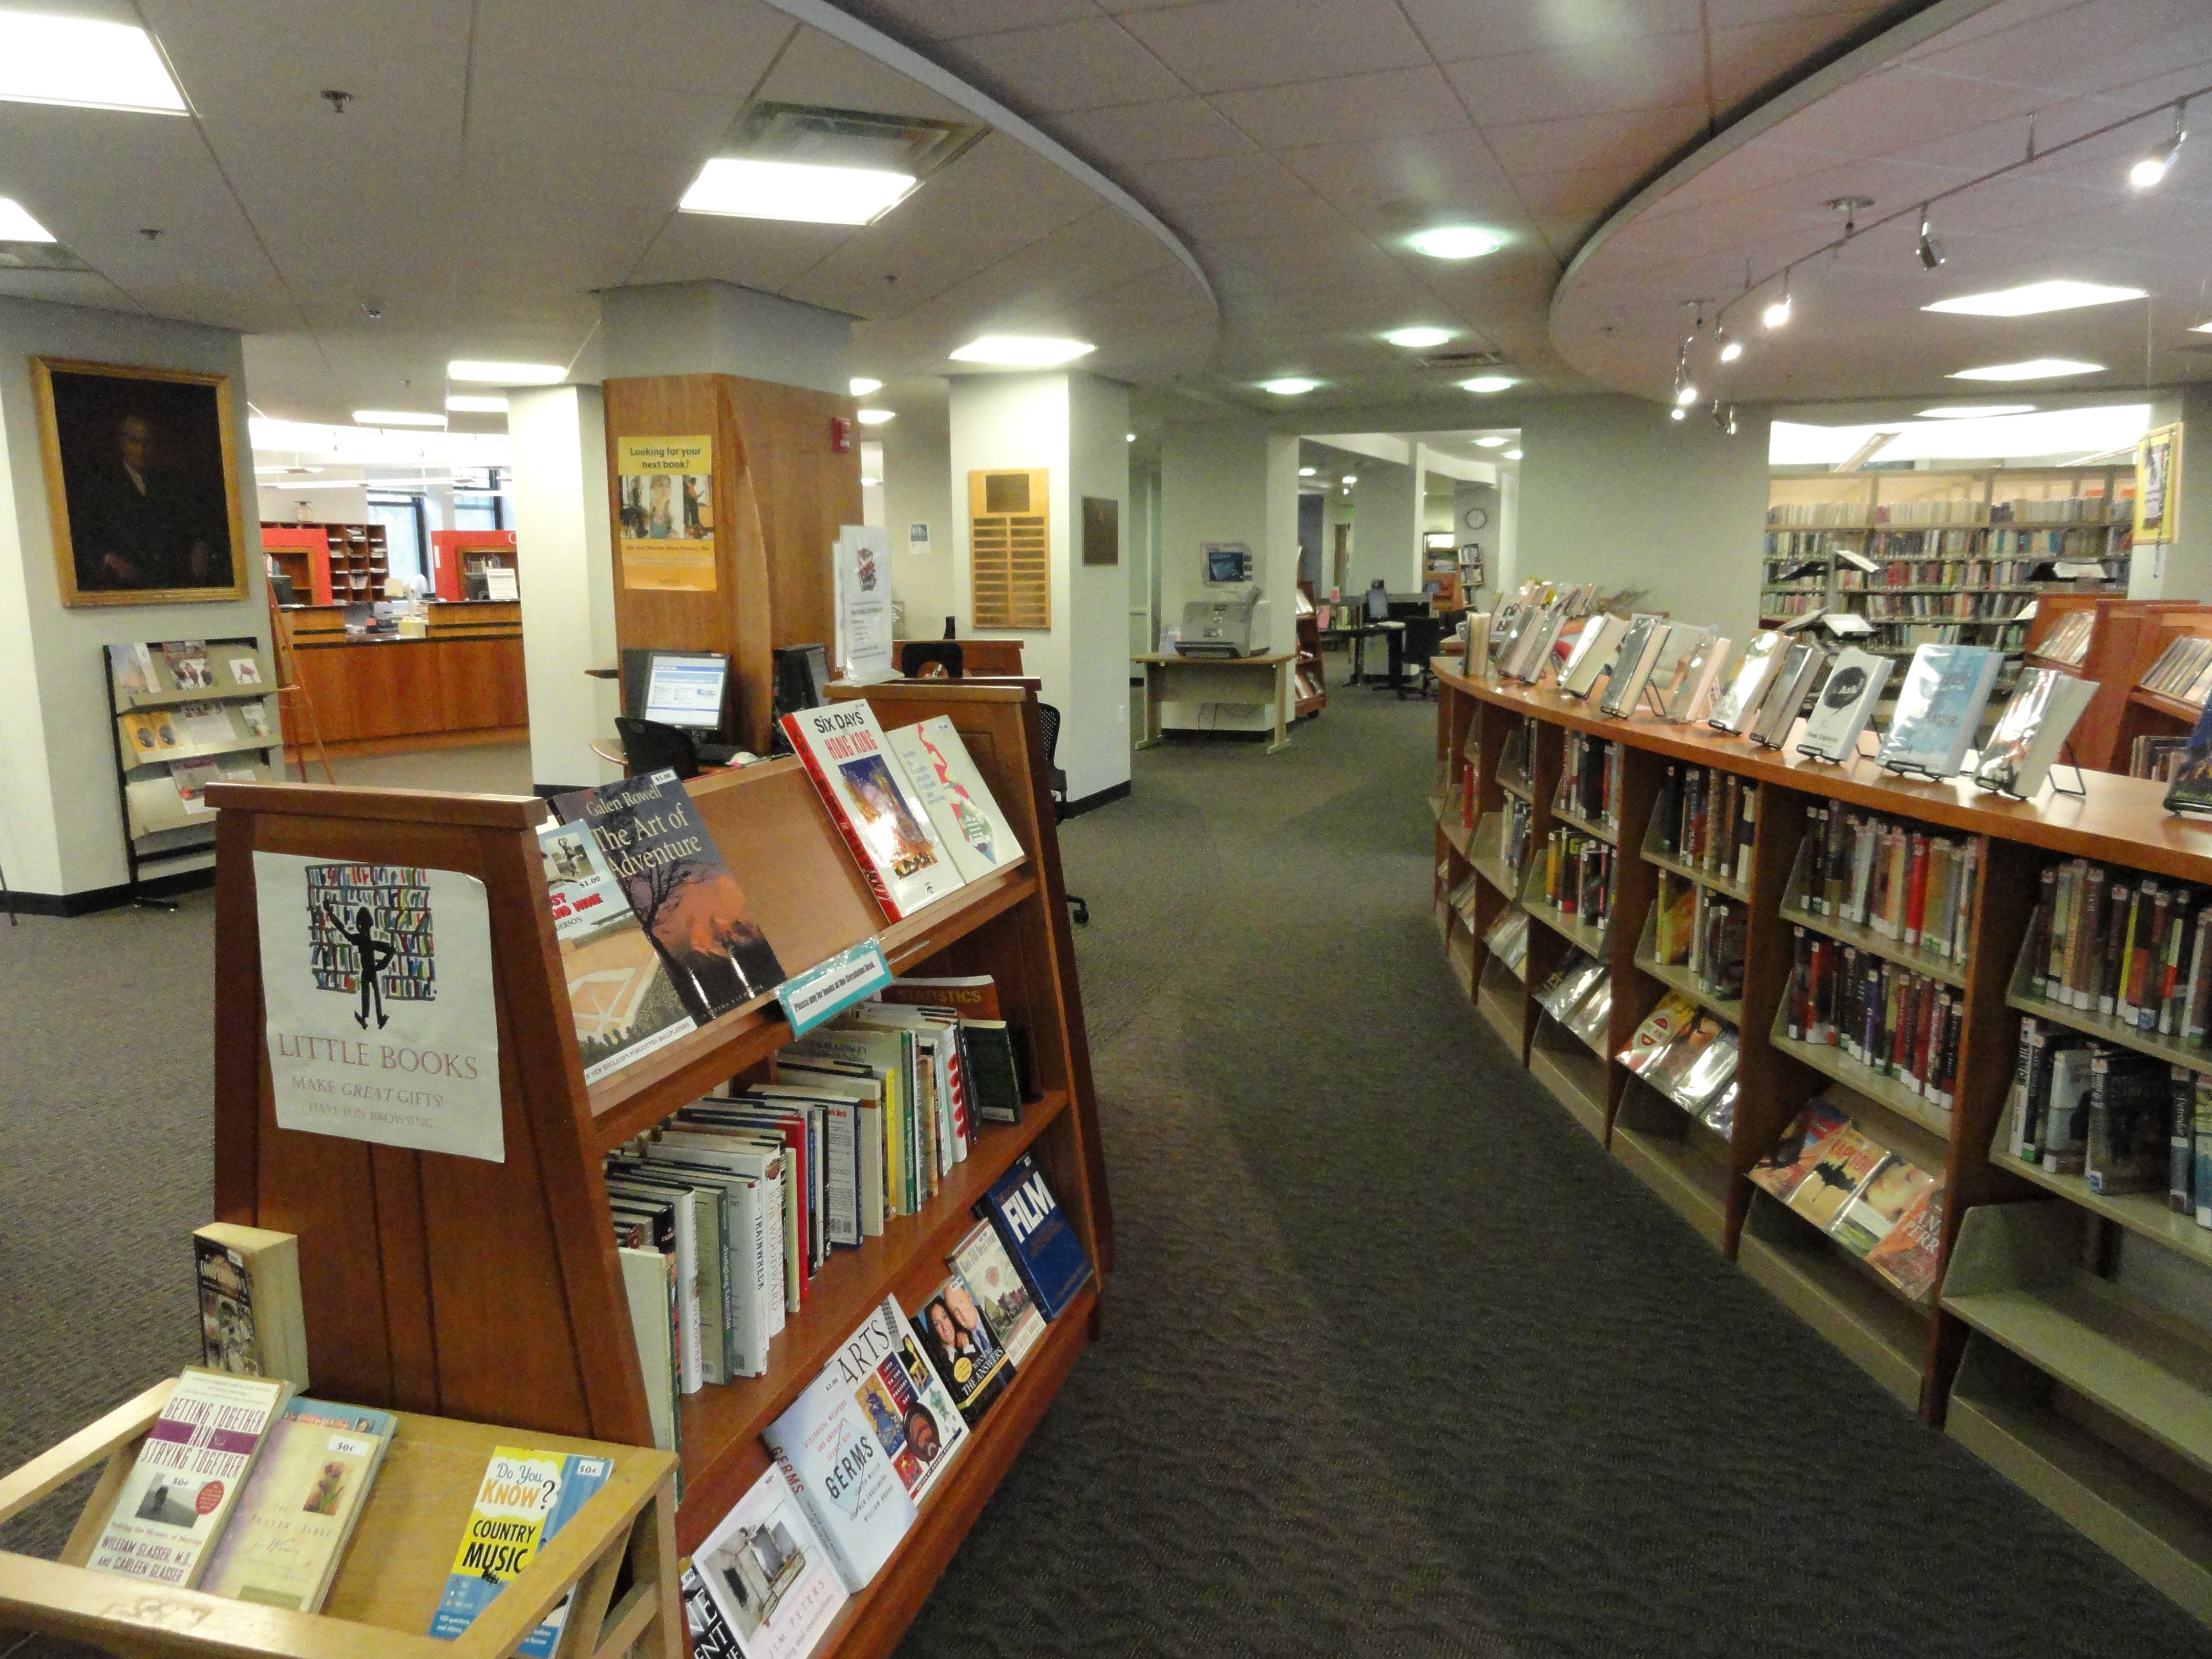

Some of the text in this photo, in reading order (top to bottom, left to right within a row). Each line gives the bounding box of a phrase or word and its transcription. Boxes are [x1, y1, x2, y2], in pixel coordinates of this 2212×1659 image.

[630, 446, 701, 458] Looking for your
[642, 459, 690, 470] next book?
[834, 711, 865, 730] DAYS
[824, 729, 878, 760] HONG KONG
[586, 783, 662, 817] Galen Rowell
[593, 802, 690, 852] The Art of
[608, 835, 702, 880] Adventure
[579, 876, 601, 889] $1.00
[572, 892, 604, 912] NINE
[794, 998, 810, 1012] Please
[809, 995, 818, 1005] pay
[822, 984, 836, 996] books
[834, 981, 840, 989] at
[845, 966, 865, 983] Circulation
[898, 989, 982, 1003] STATISTICS
[279, 1033, 478, 1080] LITTLE BOOKS
[603, 1054, 630, 1072] ENGLAND'S
[629, 1039, 658, 1056] FORGOTTEN
[658, 1022, 691, 1043] BALLPLAYERS
[292, 1075, 444, 1108] MAKE GREAT GIFTS!
[343, 1108, 366, 1120] FUN
[1001, 1170, 1056, 1244] FILM
[755, 1214, 764, 1291] TRAINWRECK
[769, 1224, 779, 1311] WOODWARD
[723, 1244, 732, 1330] Judging Lincoln
[692, 1301, 701, 1373] WOODWARD
[837, 1320, 890, 1386] ARTS
[825, 1377, 839, 1392] $1.00
[962, 1346, 1004, 1397] THE ANSWERS
[165, 1396, 215, 1424] GETTING
[212, 1405, 266, 1433] TOGETHER
[188, 1424, 216, 1448] AND
[143, 1438, 245, 1479] STAYING TOGETHER
[496, 1462, 543, 1484] Do You
[772, 1447, 804, 1494] GERMS
[825, 1435, 874, 1500] GERMS
[250, 1514, 291, 1529] PRAYER
[302, 1524, 333, 1538] JABEZ
[472, 1519, 537, 1544] COUNTRY
[101, 1536, 137, 1554] WILLIAM
[461, 1541, 529, 1575] MUSIC
[97, 1556, 184, 1583] AND CARLEEN GLASSER
[768, 1632, 786, 1659] JIM
[790, 1578, 826, 1626] PETERS
